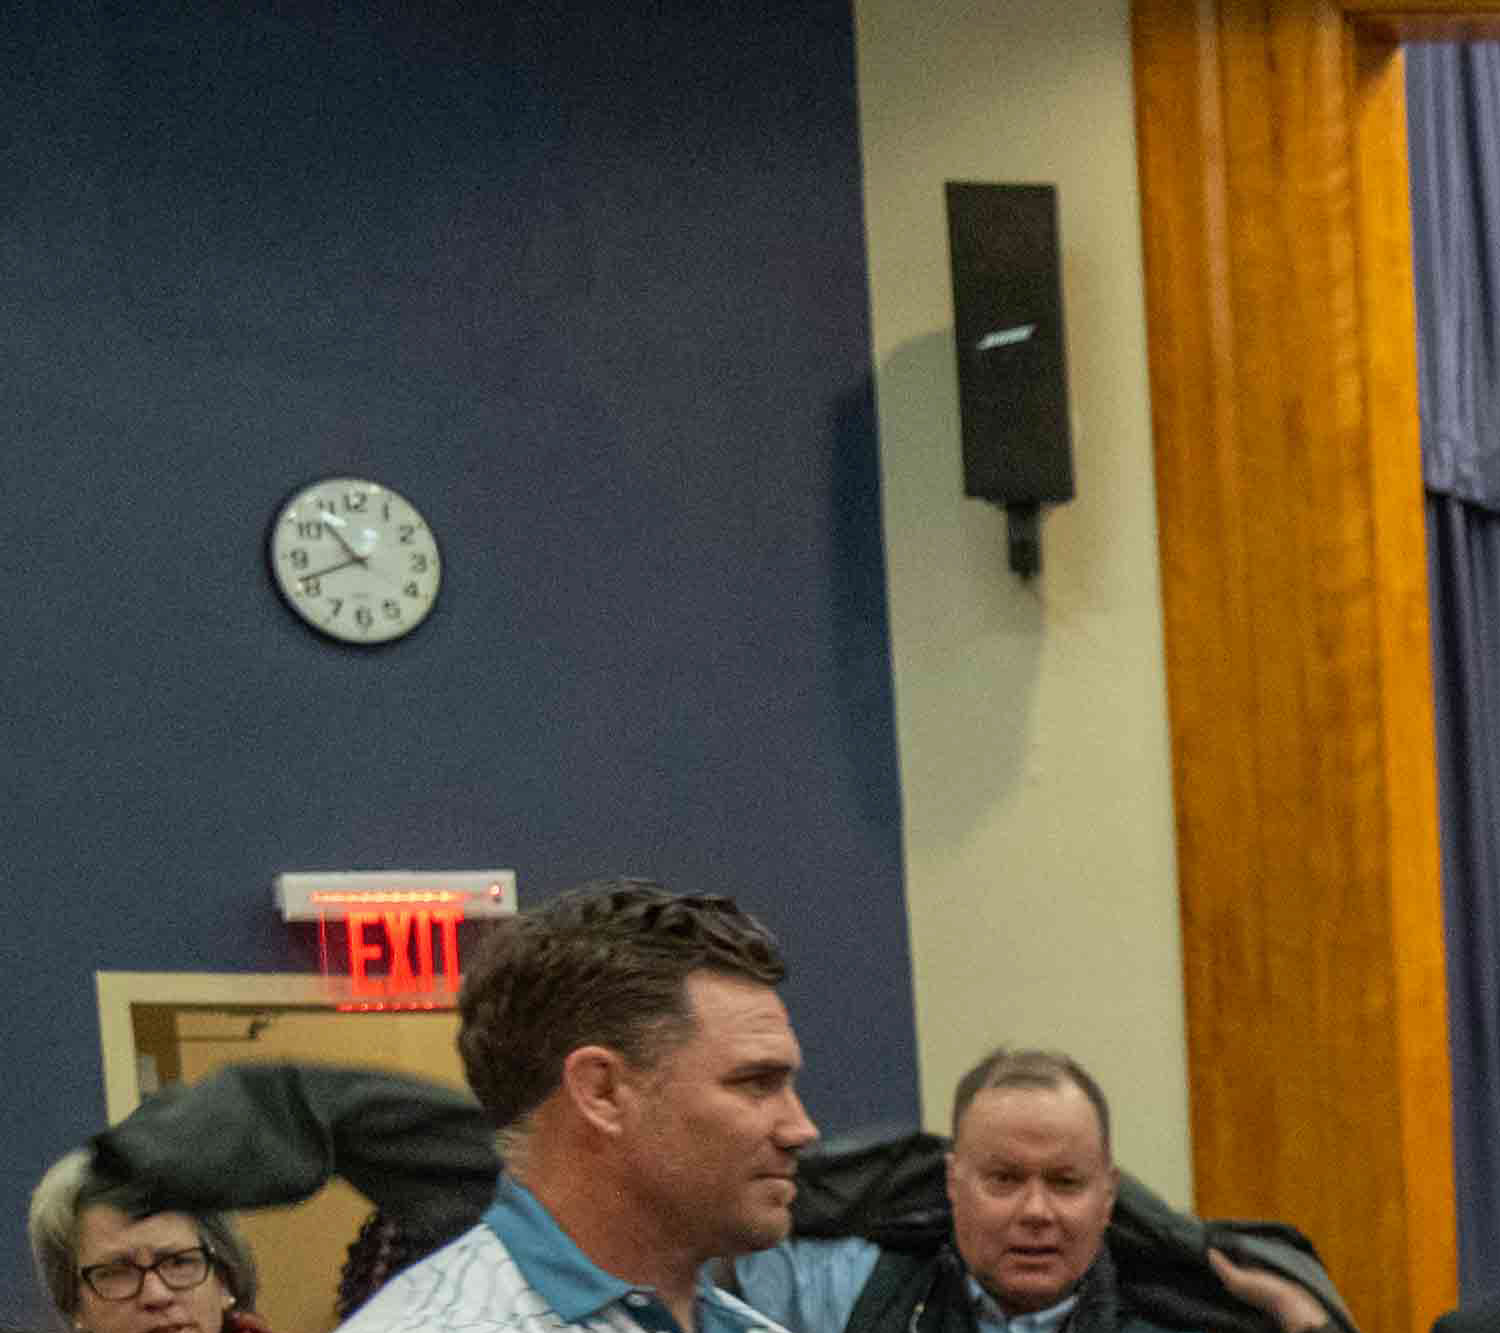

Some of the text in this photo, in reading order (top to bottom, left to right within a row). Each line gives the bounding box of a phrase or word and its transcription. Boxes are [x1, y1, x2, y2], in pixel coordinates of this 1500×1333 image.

[344, 493, 368, 512] 12
[298, 521, 322, 540] 10
[398, 525, 415, 545] 2
[290, 549, 308, 569] 9
[411, 554, 428, 574] 3
[404, 581, 420, 598] 4
[329, 597, 344, 617] 7
[355, 606, 374, 628] 6
[382, 600, 401, 620] 5
[346, 909, 465, 998] EXIT
